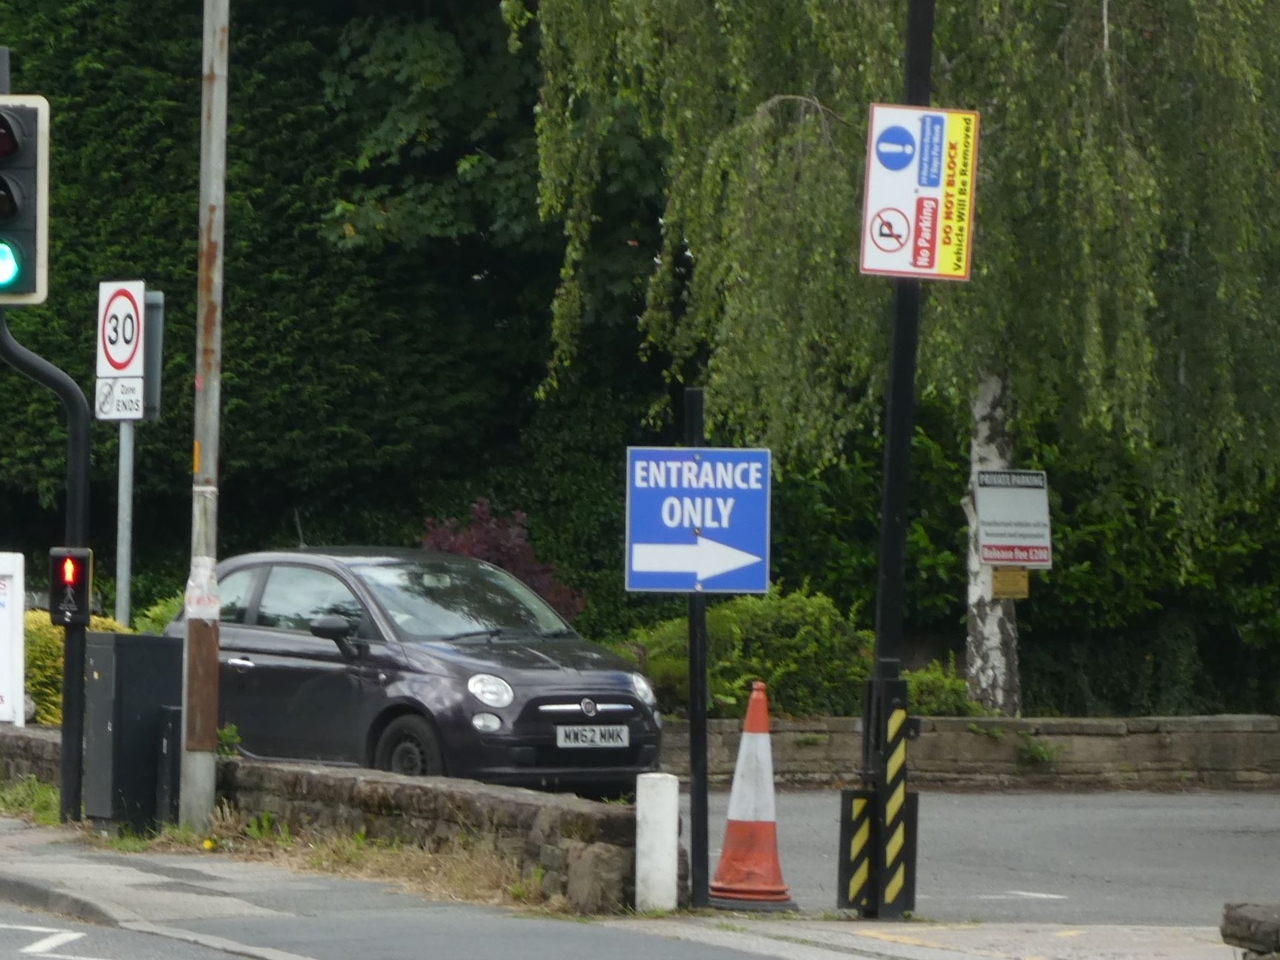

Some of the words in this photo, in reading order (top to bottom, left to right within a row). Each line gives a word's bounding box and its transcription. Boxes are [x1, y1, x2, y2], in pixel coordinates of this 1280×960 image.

[960, 117, 973, 177] Removed
[946, 142, 958, 187] BLOCK
[958, 182, 968, 196] Be
[944, 192, 955, 221] NOT
[956, 197, 967, 222] Will
[919, 199, 936, 248] Parking
[942, 225, 953, 245] DO
[916, 251, 930, 267] No
[953, 225, 965, 271] Vehicle
[108, 313, 135, 345] 30
[120, 384, 136, 395] Zone
[116, 399, 140, 412] ENDS
[634, 460, 763, 490] ENTRANCE
[979, 473, 1011, 487] PRIVATE
[1012, 474, 1044, 488] PARKING
[661, 496, 735, 528] ONLY
[983, 547, 1014, 560] Release
